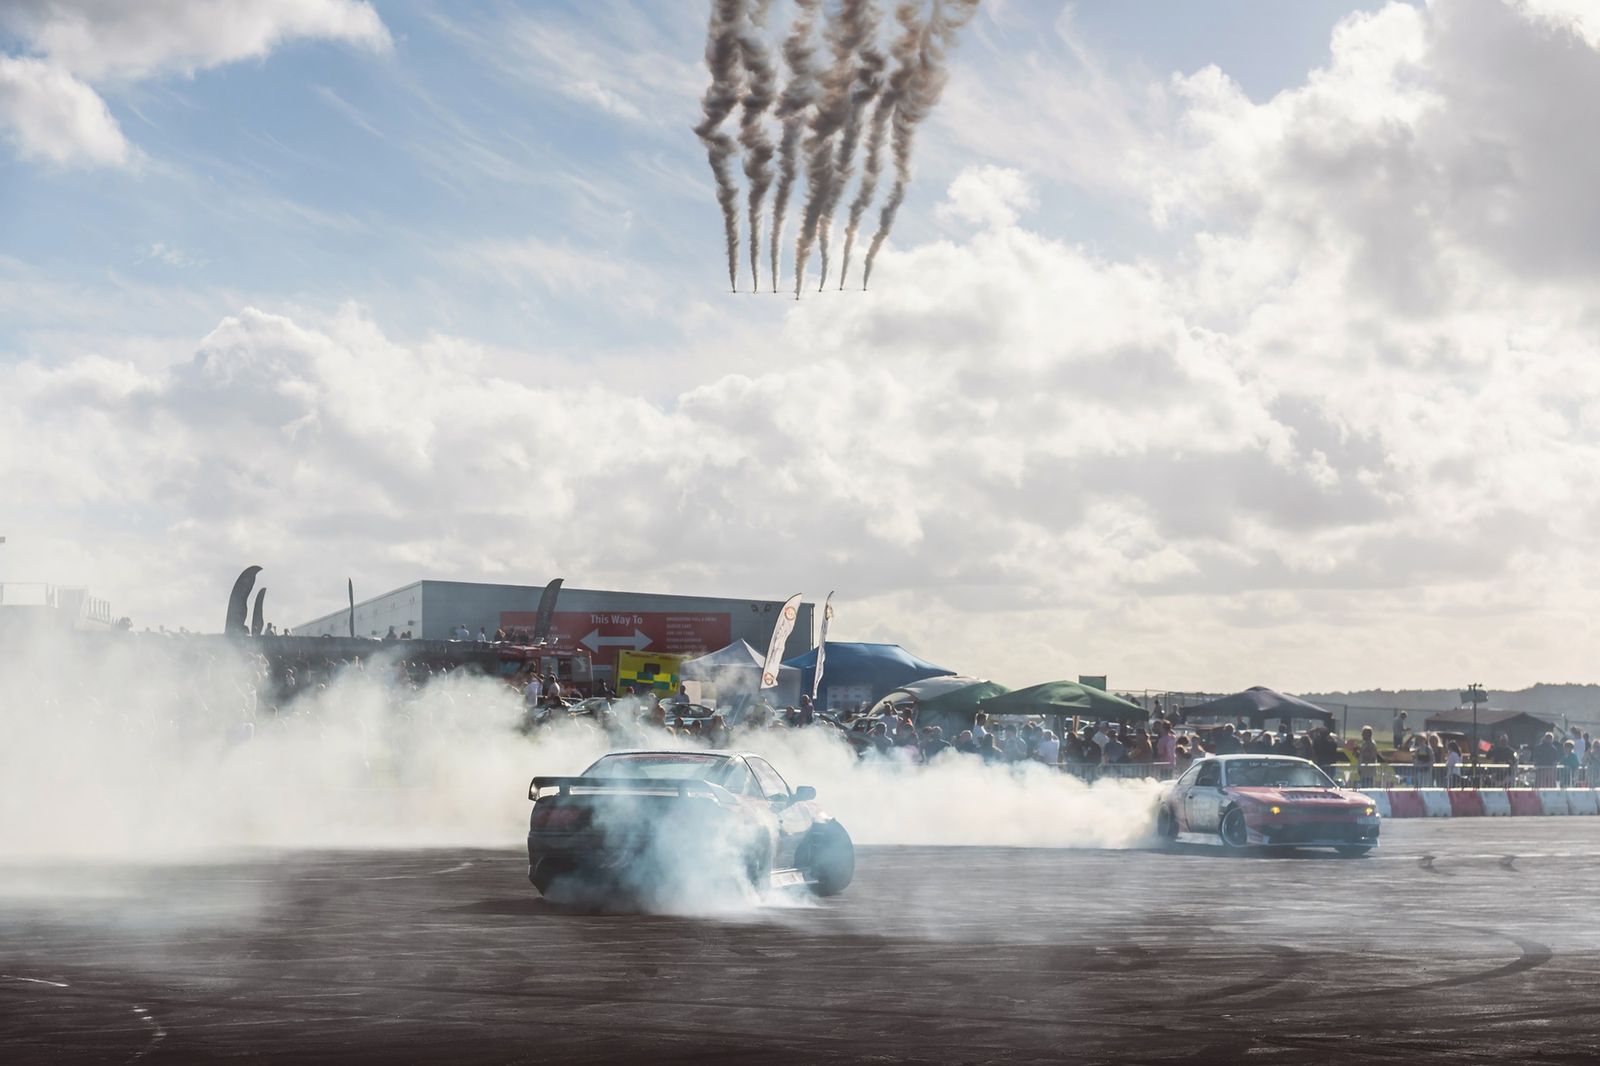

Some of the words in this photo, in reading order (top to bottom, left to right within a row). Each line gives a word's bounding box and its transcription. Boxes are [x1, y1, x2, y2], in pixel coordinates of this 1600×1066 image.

[591, 614, 609, 624] This
[611, 614, 631, 626] Way
[632, 615, 643, 624] To
